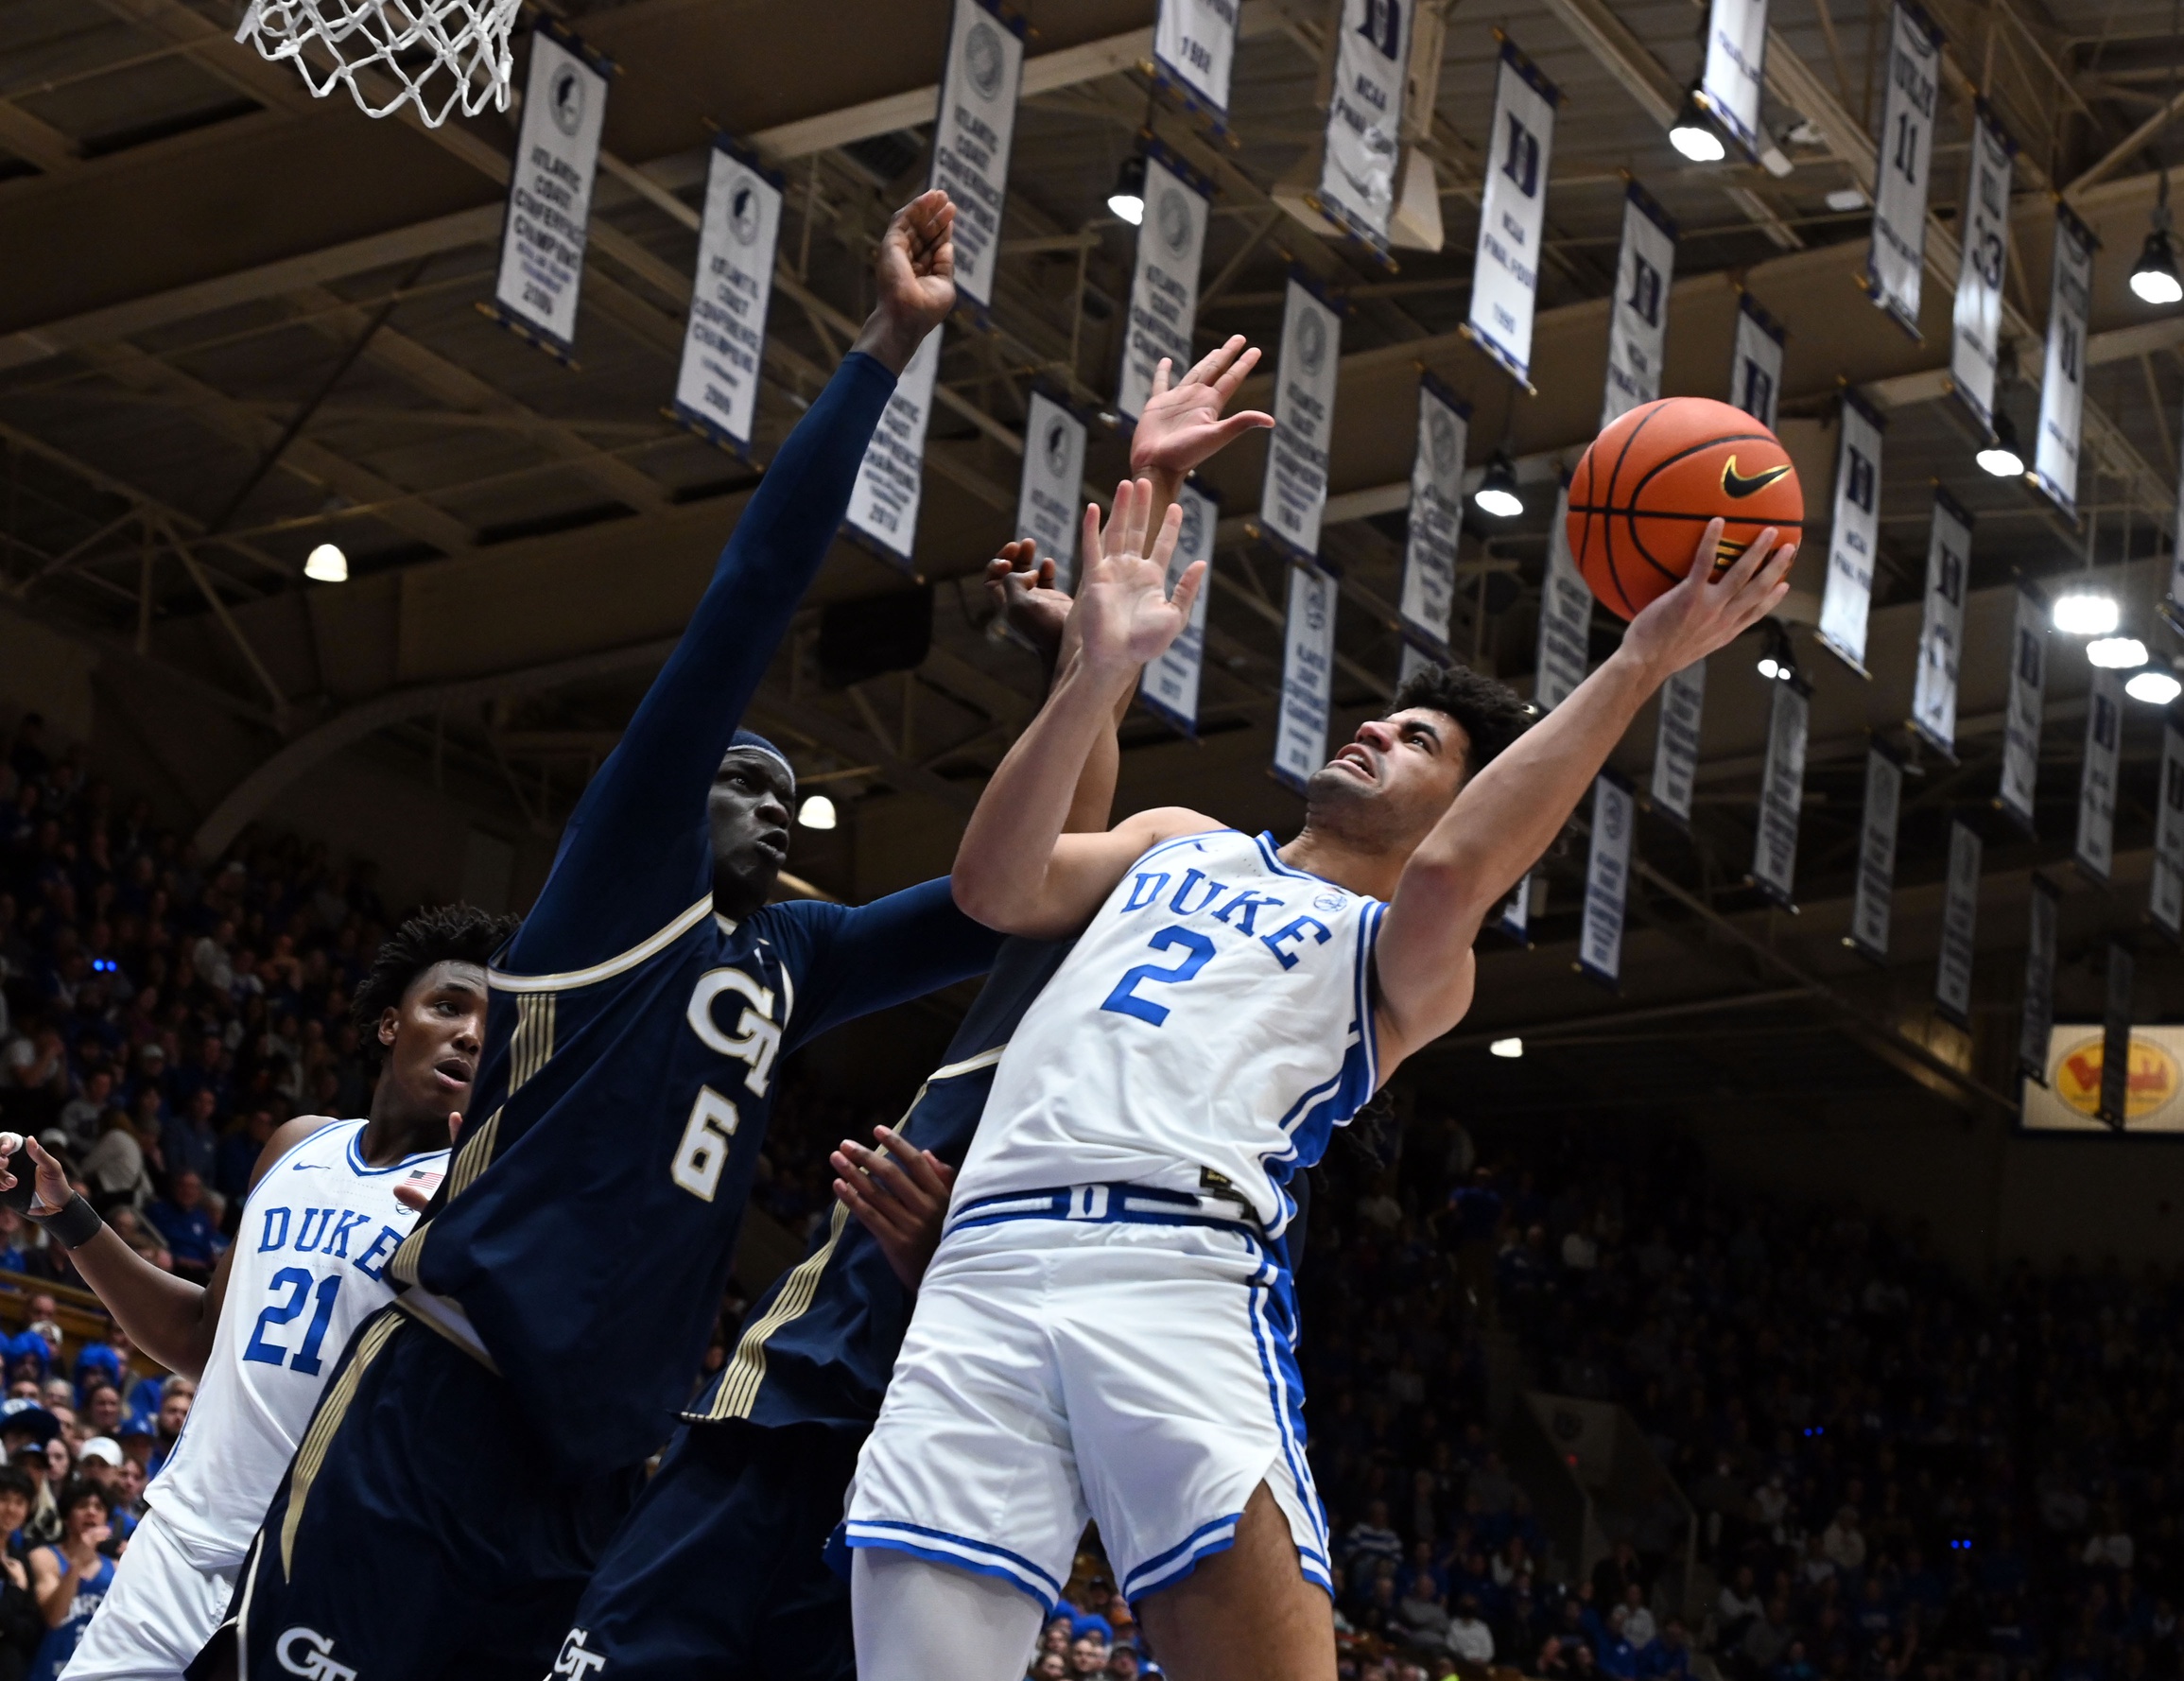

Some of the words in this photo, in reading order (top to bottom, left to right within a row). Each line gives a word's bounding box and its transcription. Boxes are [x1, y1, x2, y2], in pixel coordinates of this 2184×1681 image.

[1896, 113, 1916, 186] 11
[1120, 868, 1332, 971] DUKE
[1100, 925, 1217, 1028] 2
[670, 1084, 739, 1203] 6
[257, 1206, 404, 1282] DUKE
[1066, 1184, 1110, 1220] D
[243, 1267, 341, 1376] 21
